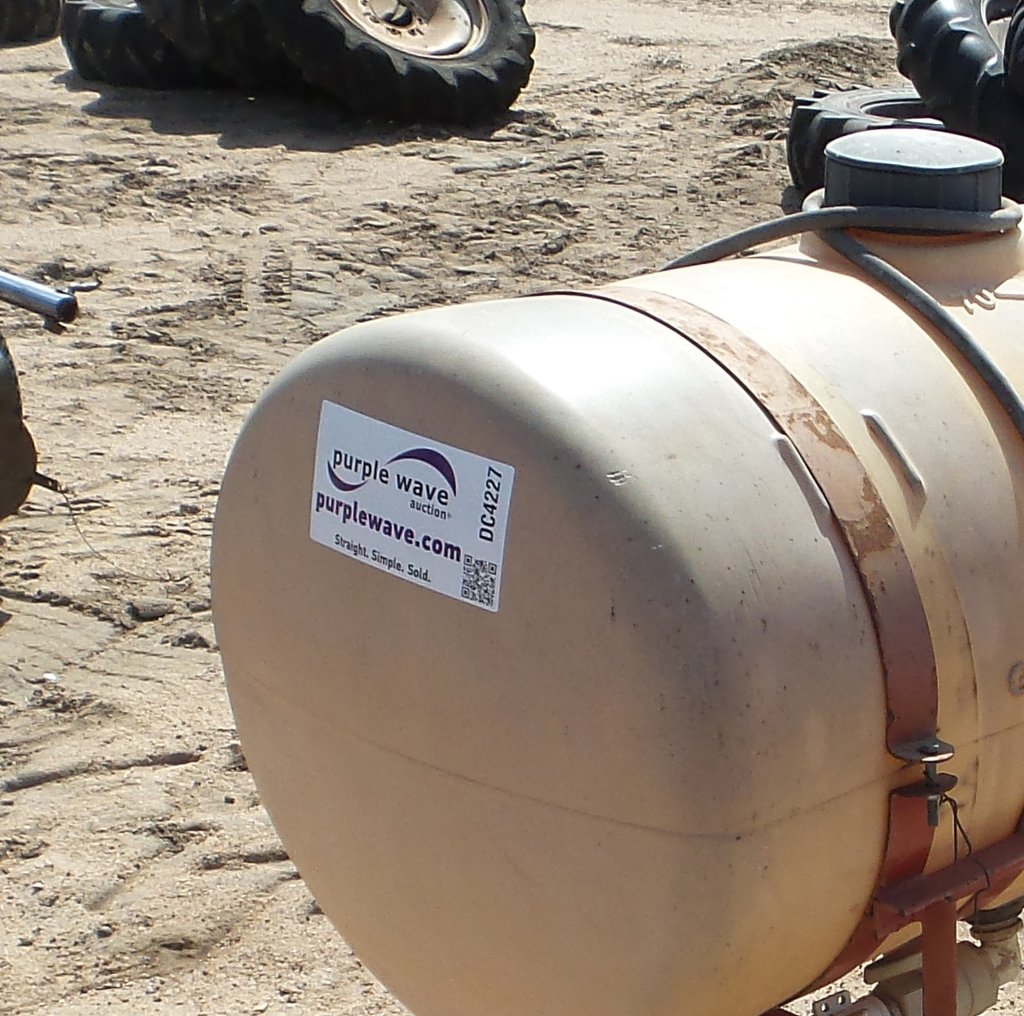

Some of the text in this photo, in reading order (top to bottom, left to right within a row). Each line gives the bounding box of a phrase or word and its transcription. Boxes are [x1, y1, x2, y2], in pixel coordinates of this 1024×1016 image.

[332, 448, 449, 506] purple wave
[479, 465, 503, 543] DC4227
[315, 491, 462, 563] purplewave.com
[409, 499, 447, 521] auction
[334, 533, 432, 584] Straight. Simple. Sold.
